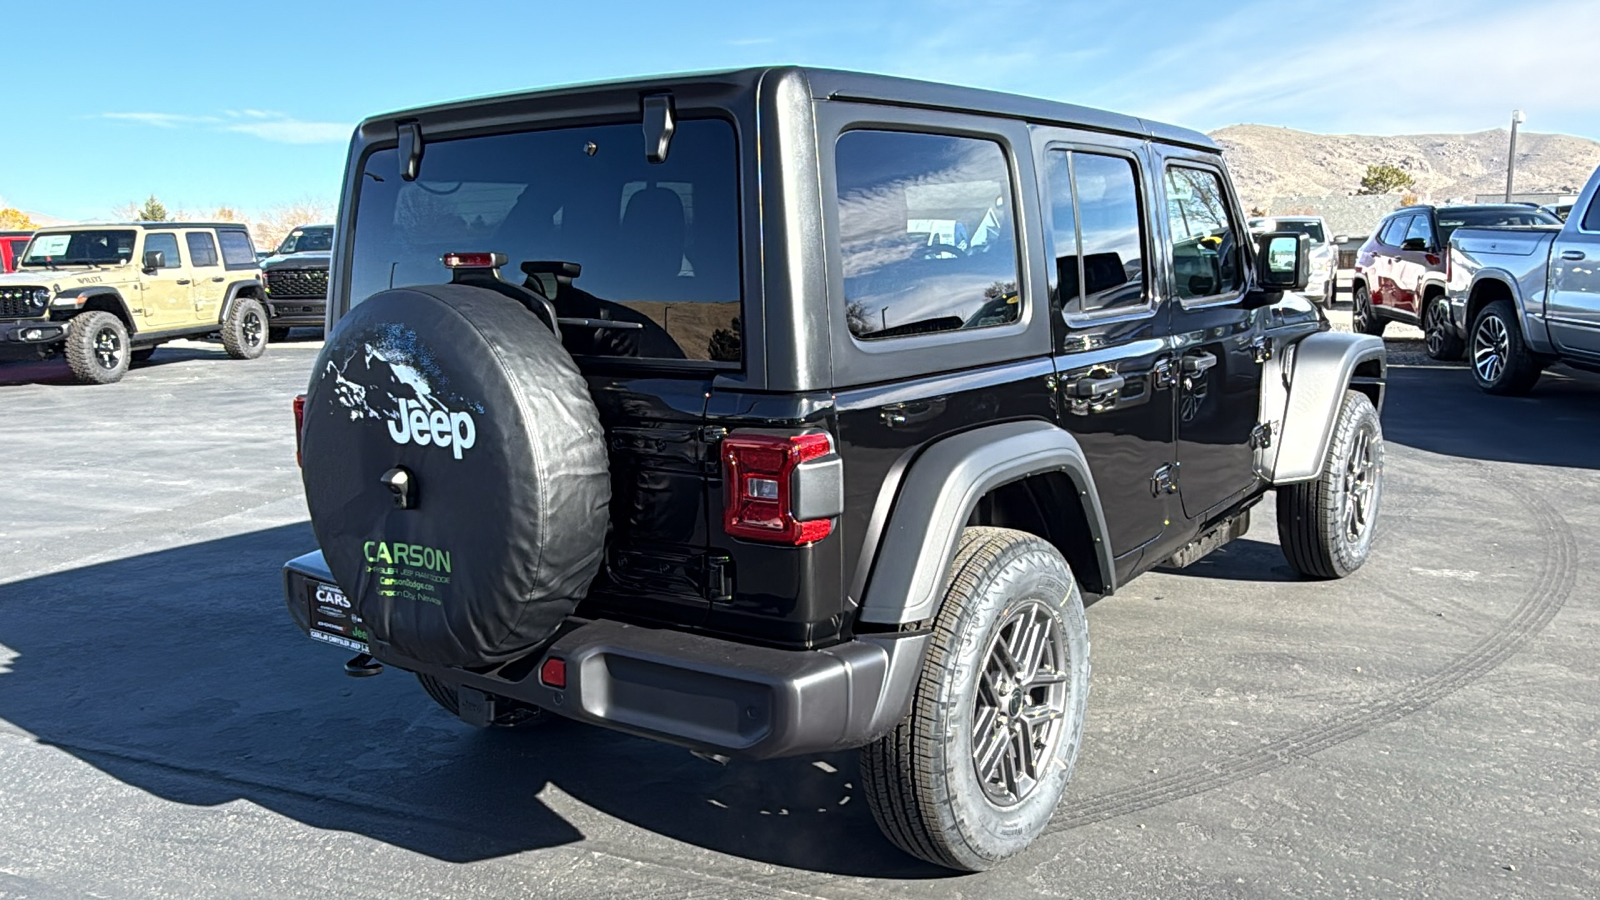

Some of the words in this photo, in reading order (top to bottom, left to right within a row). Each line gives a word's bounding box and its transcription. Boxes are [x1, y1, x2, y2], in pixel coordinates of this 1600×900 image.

[387, 398, 476, 460] Jeep
[363, 541, 451, 573] CARSON
[352, 626, 368, 640] Jee
